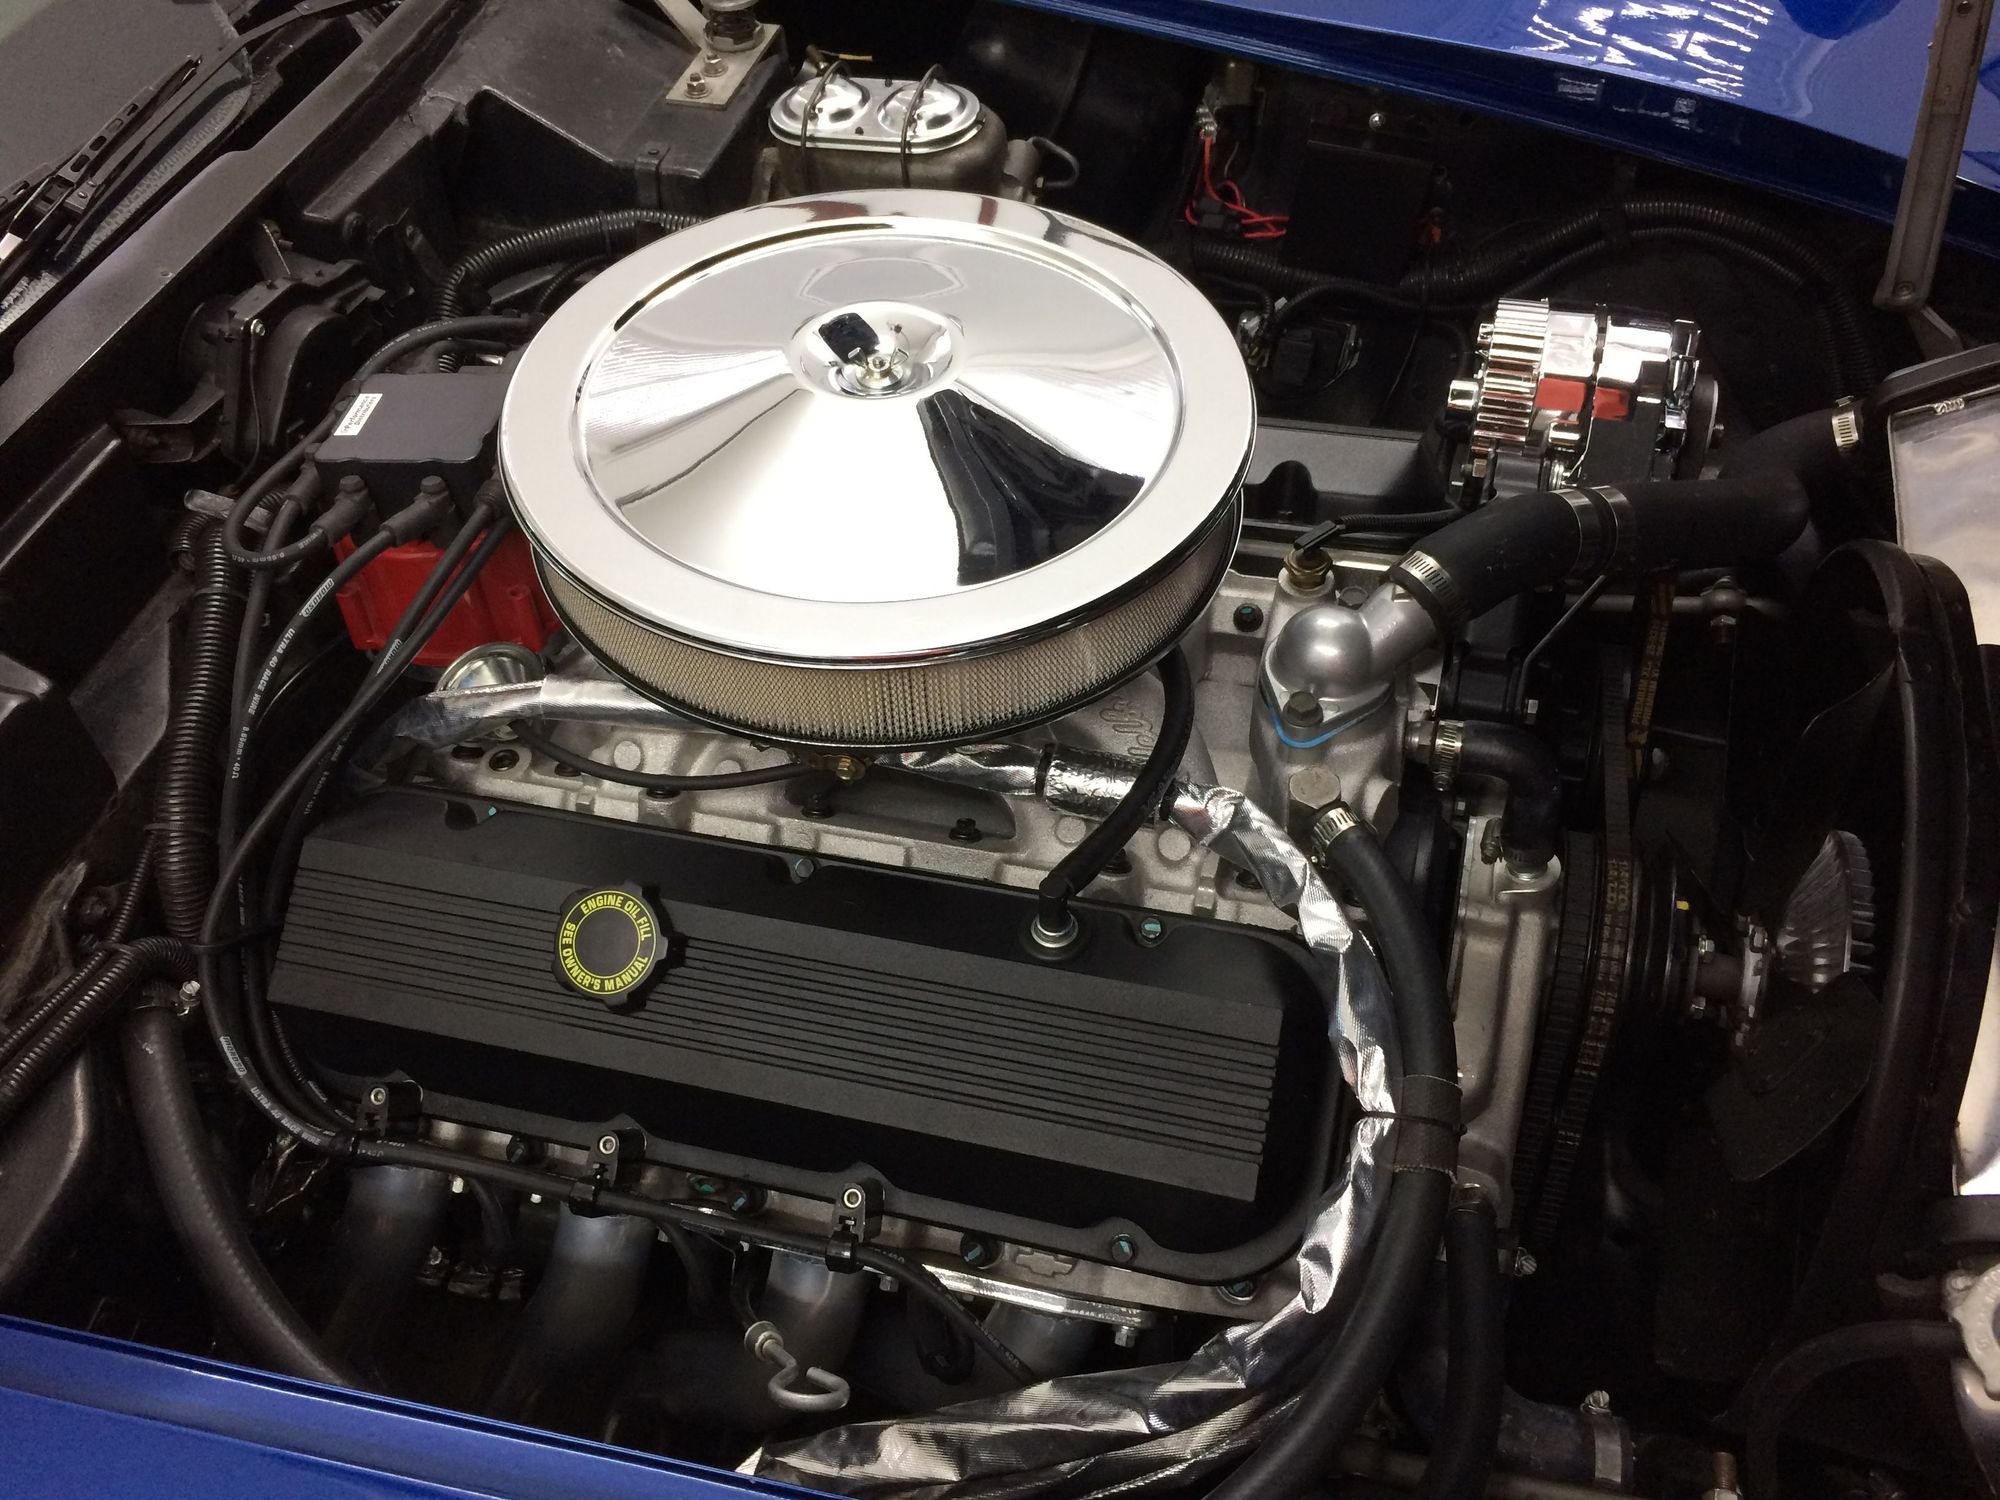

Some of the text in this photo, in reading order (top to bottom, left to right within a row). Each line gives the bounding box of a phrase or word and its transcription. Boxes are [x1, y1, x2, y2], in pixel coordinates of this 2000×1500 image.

[276, 628, 295, 654] ULTRA
[269, 656, 279, 668] 40
[257, 668, 272, 692] RACE
[248, 693, 261, 715] WIRE
[580, 894, 652, 941] ENGINE OIL FILL
[562, 922, 648, 991] SEE OWNER'S MANUAL
[250, 1086, 271, 1110] ULTRA
[271, 1109, 281, 1119] 40
[280, 1118, 300, 1135] RACE
